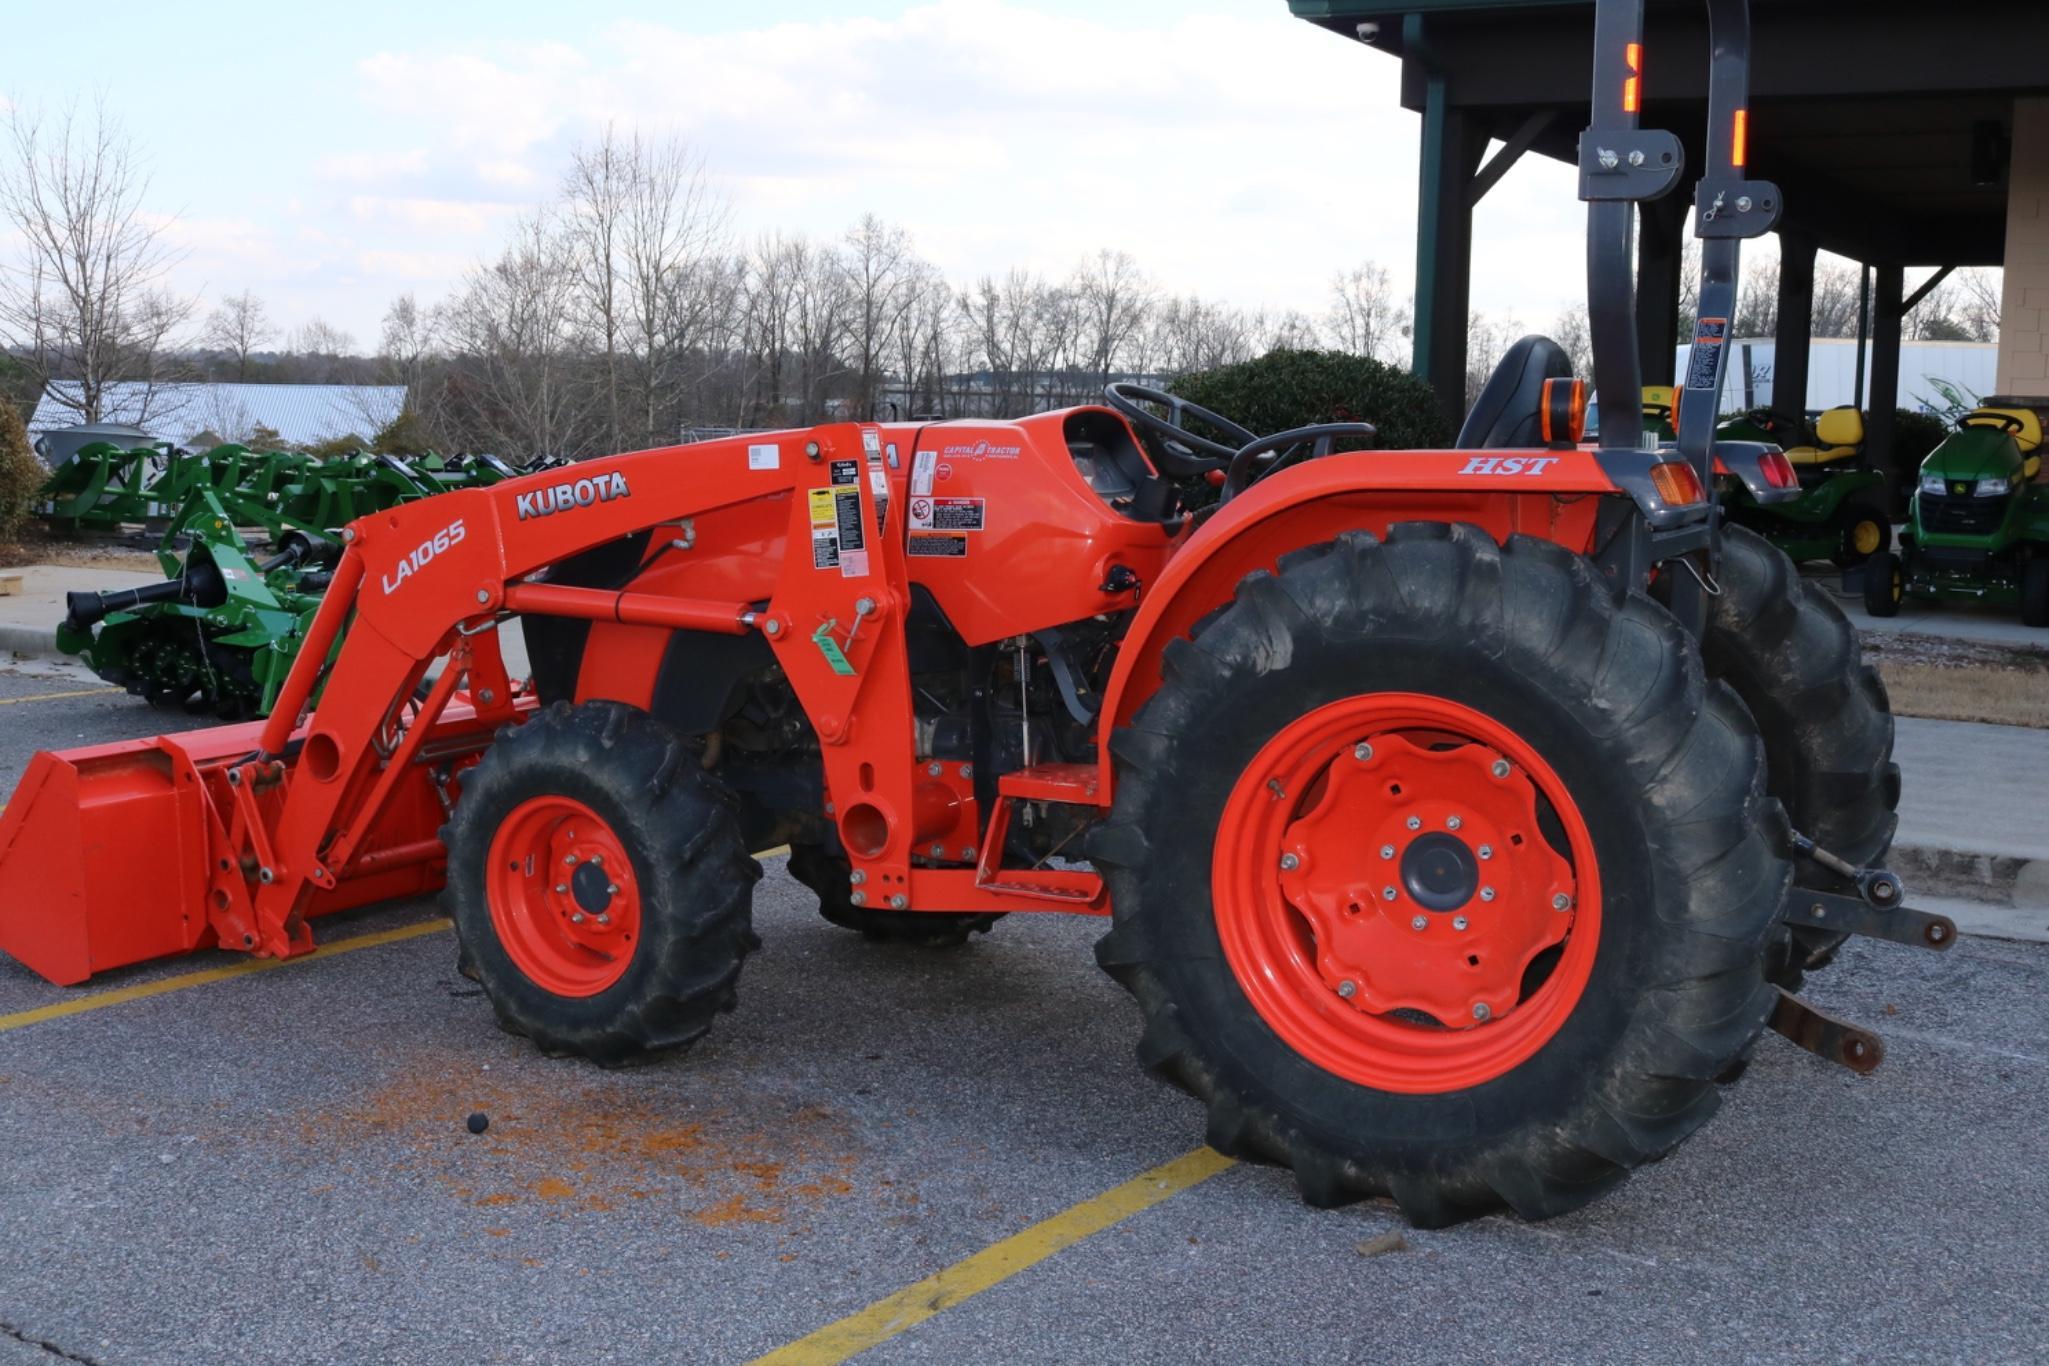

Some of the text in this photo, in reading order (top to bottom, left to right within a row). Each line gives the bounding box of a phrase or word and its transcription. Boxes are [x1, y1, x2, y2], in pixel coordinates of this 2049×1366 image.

[944, 446, 1021, 455] CAPITAL TRACTOR
[1458, 457, 1559, 475] HST
[515, 471, 631, 521] KUBOTA
[382, 518, 467, 595] LA1065
